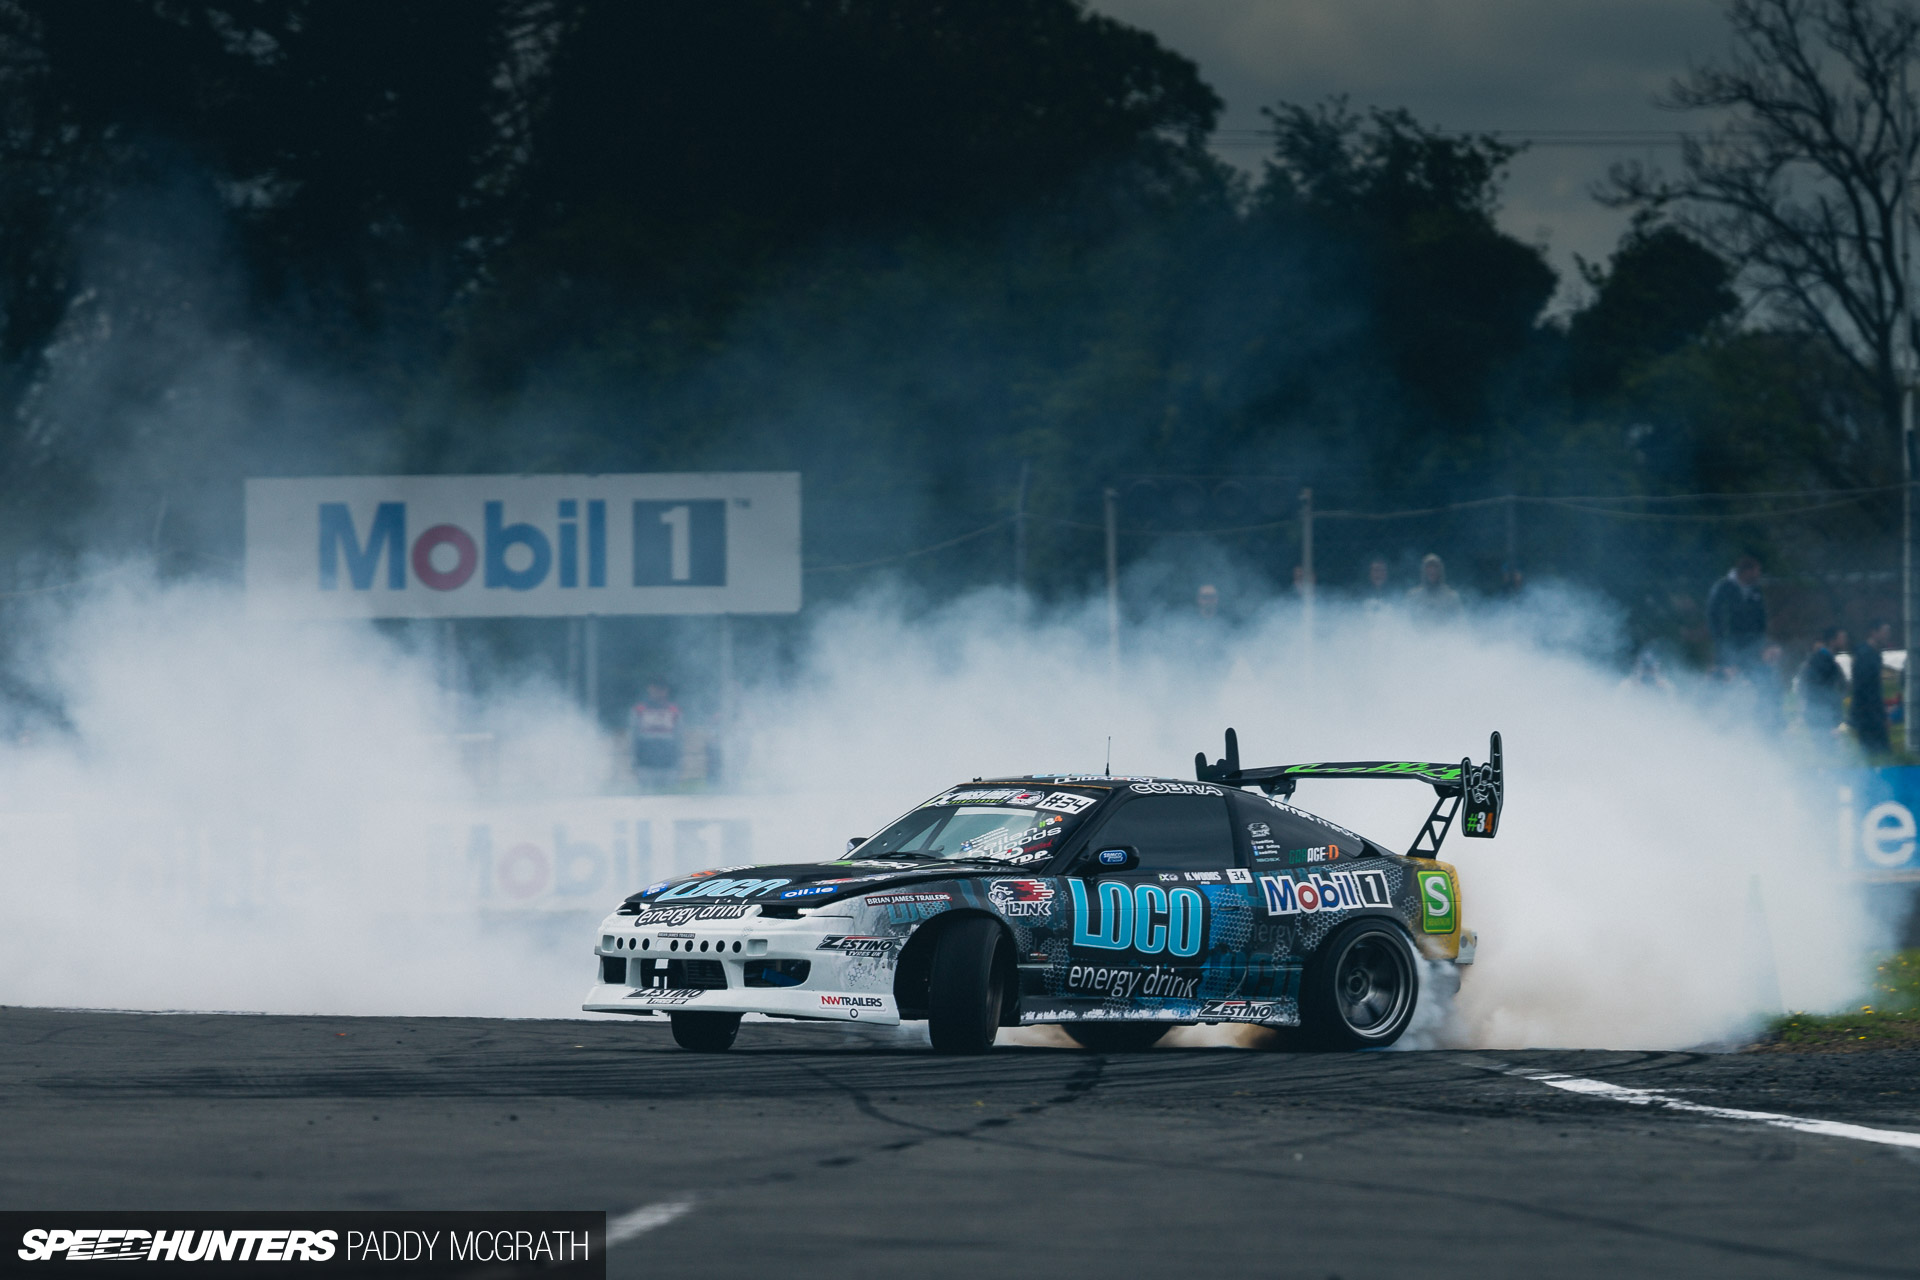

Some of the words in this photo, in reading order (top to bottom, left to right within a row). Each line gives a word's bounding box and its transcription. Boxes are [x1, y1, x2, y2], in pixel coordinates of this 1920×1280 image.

[318, 500, 607, 591] Mobil
[1129, 782, 1224, 797] COBRA
[1466, 811, 1494, 833] #34
[462, 817, 652, 902] obil
[1231, 871, 1247, 881] 34
[866, 896, 891, 905] BRIAN
[890, 895, 915, 904] JAMES
[915, 893, 951, 902] TRAILERS
[1260, 872, 1362, 916] Mobil
[637, 906, 699, 926] energy
[699, 899, 749, 918] drink
[1008, 901, 1052, 916] LINK
[1067, 878, 1203, 958] LOCO
[818, 937, 894, 951] ZESTINO
[1069, 965, 1141, 998] energy
[1142, 964, 1198, 998] drink
[821, 995, 883, 1007] NWTRAILERS
[1201, 1002, 1271, 1019] ZESTINO
